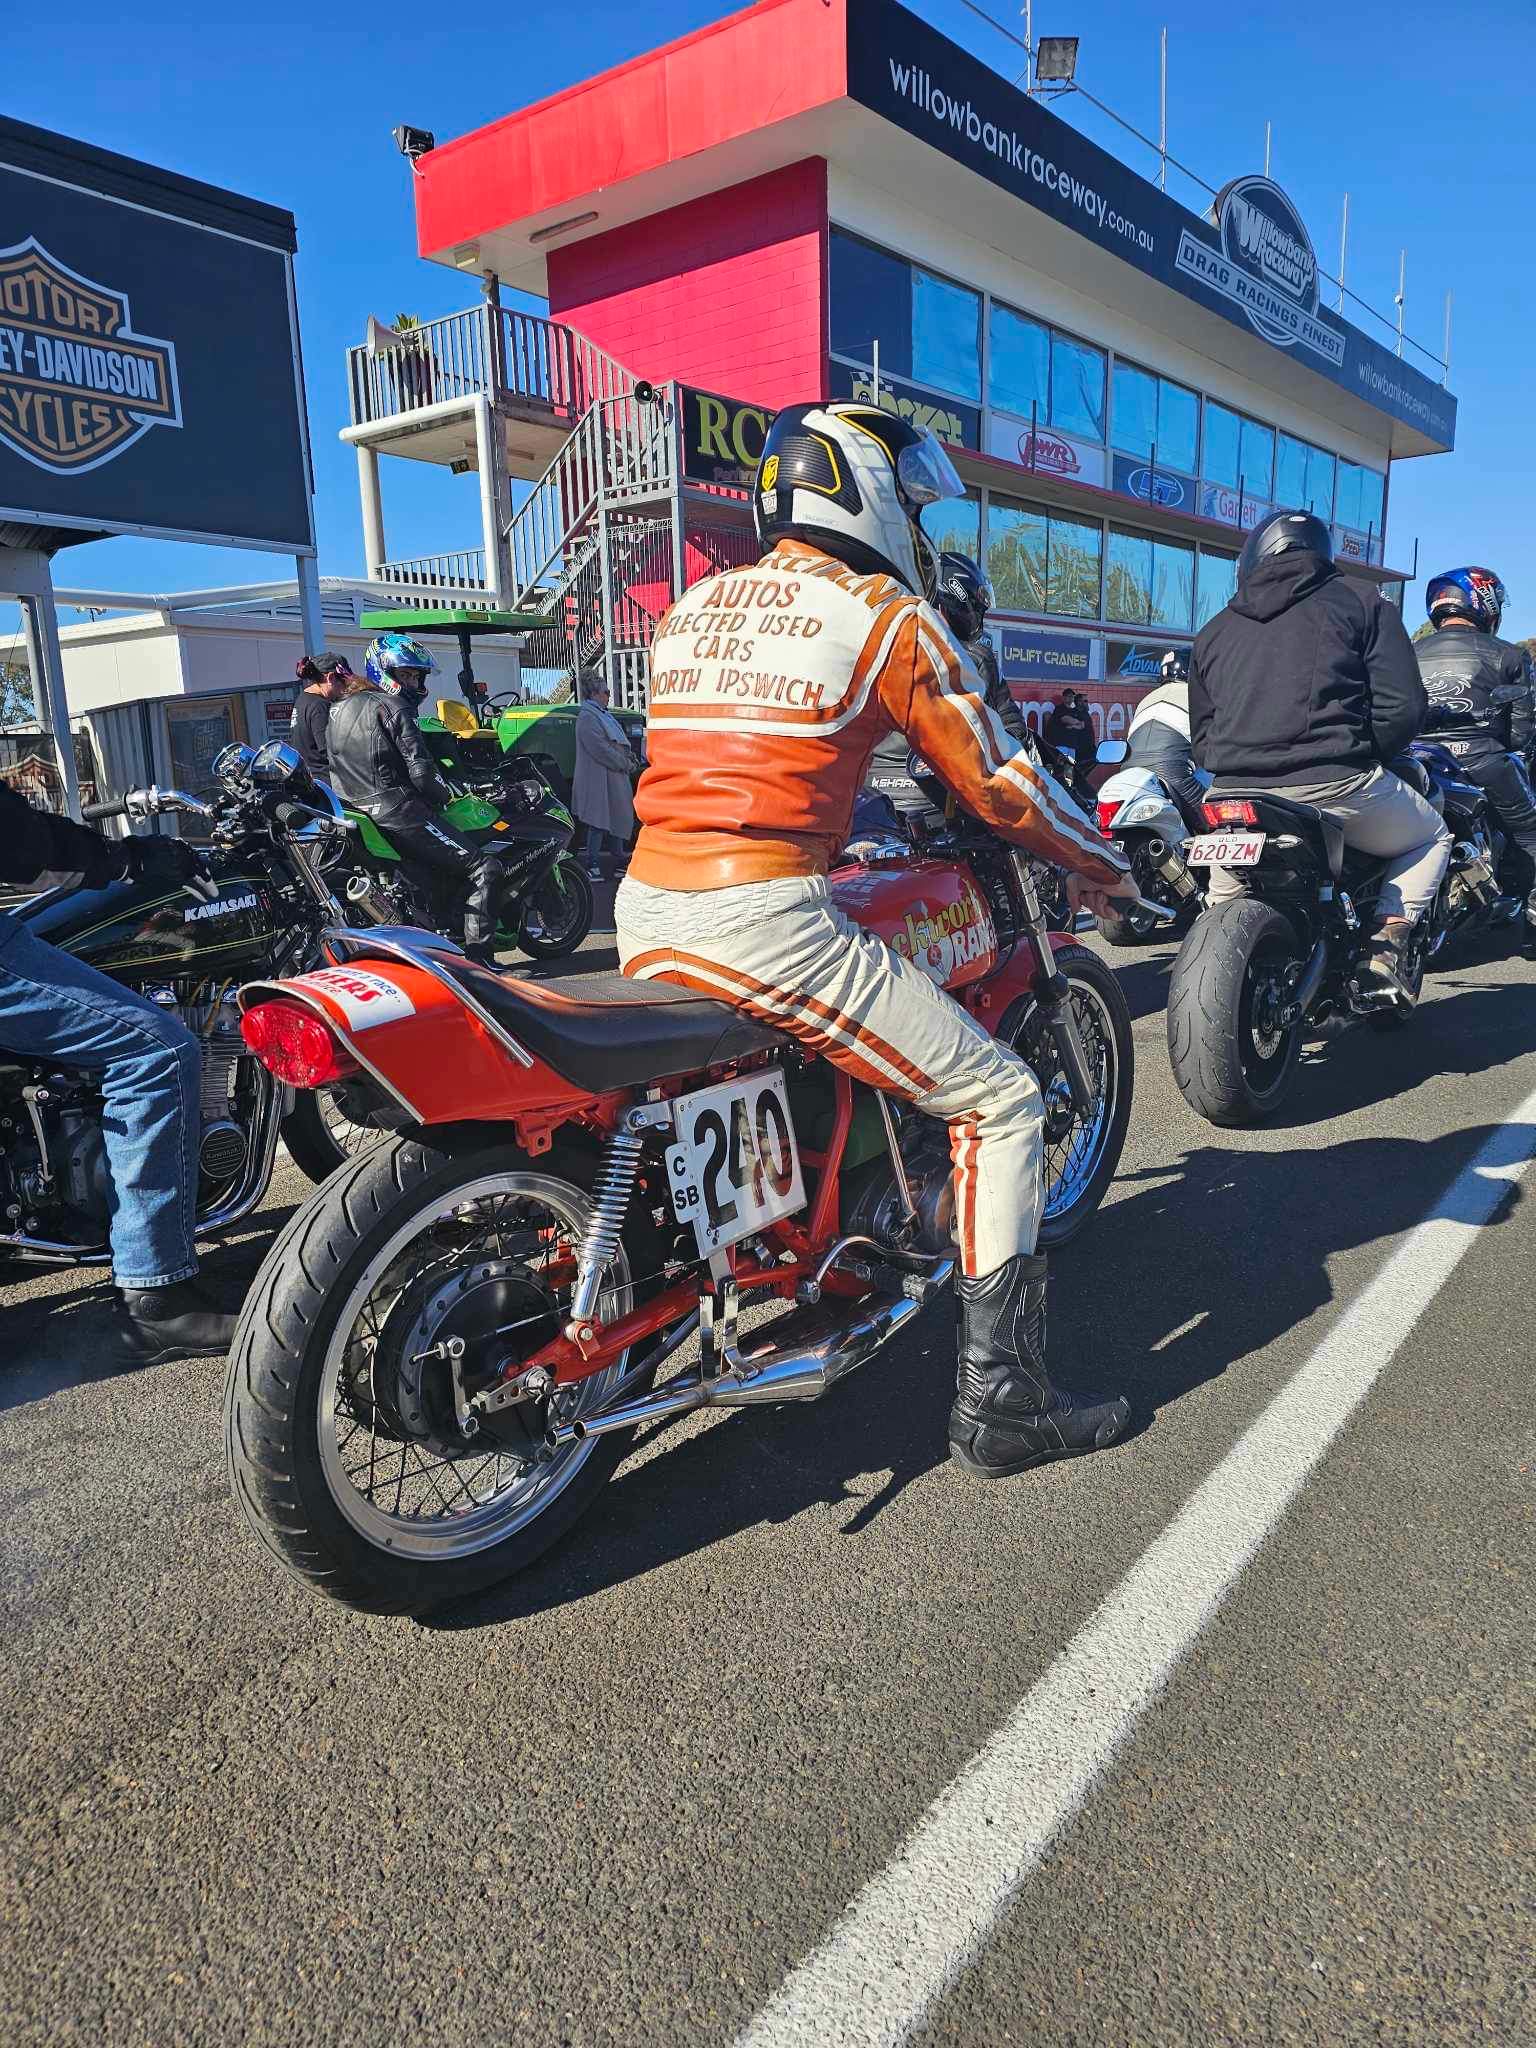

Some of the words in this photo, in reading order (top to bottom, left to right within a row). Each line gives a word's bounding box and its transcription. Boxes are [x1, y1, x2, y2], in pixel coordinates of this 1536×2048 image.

[889, 57, 1154, 252] willowbankraceway.com.au
[0, 269, 101, 333] OTOR
[1183, 243, 1229, 285] DRAG
[1237, 277, 1298, 329] RACINGS
[1302, 322, 1342, 354] FINEST
[702, 579, 801, 609] AUTOS
[758, 614, 823, 638] USED
[693, 635, 755, 662] CARS
[1004, 646, 1043, 664] UPLIFT
[1044, 651, 1088, 668] CRANES
[716, 668, 824, 708] IPSWICH
[184, 894, 257, 923] KAWASAKI
[672, 1155, 686, 1177] C
[693, 1088, 793, 1230] 240
[674, 1185, 700, 1210] SB
